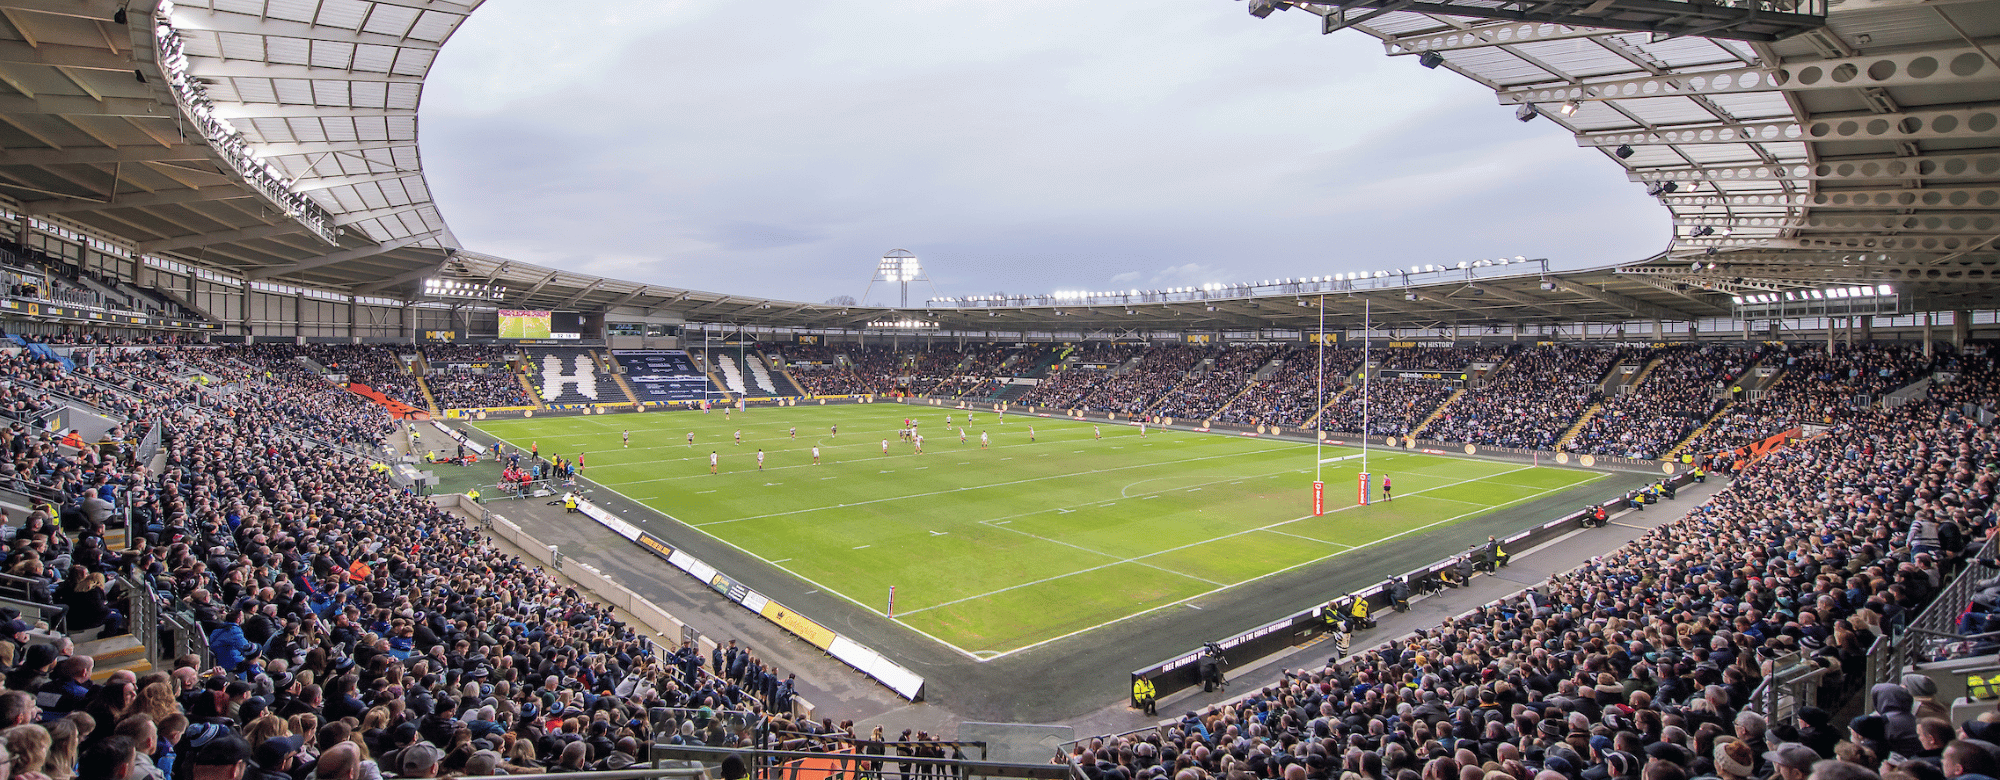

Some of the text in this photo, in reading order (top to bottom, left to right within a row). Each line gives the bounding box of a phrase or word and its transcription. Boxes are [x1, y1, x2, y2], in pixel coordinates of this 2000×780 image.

[426, 331, 455, 343] MKM
[1188, 335, 1210, 346] MKM
[1428, 440, 1459, 448] BULLION
[1481, 445, 1511, 453] DIRECT
[1612, 456, 1654, 466] BULLION
[1162, 661, 1174, 673] FREE
